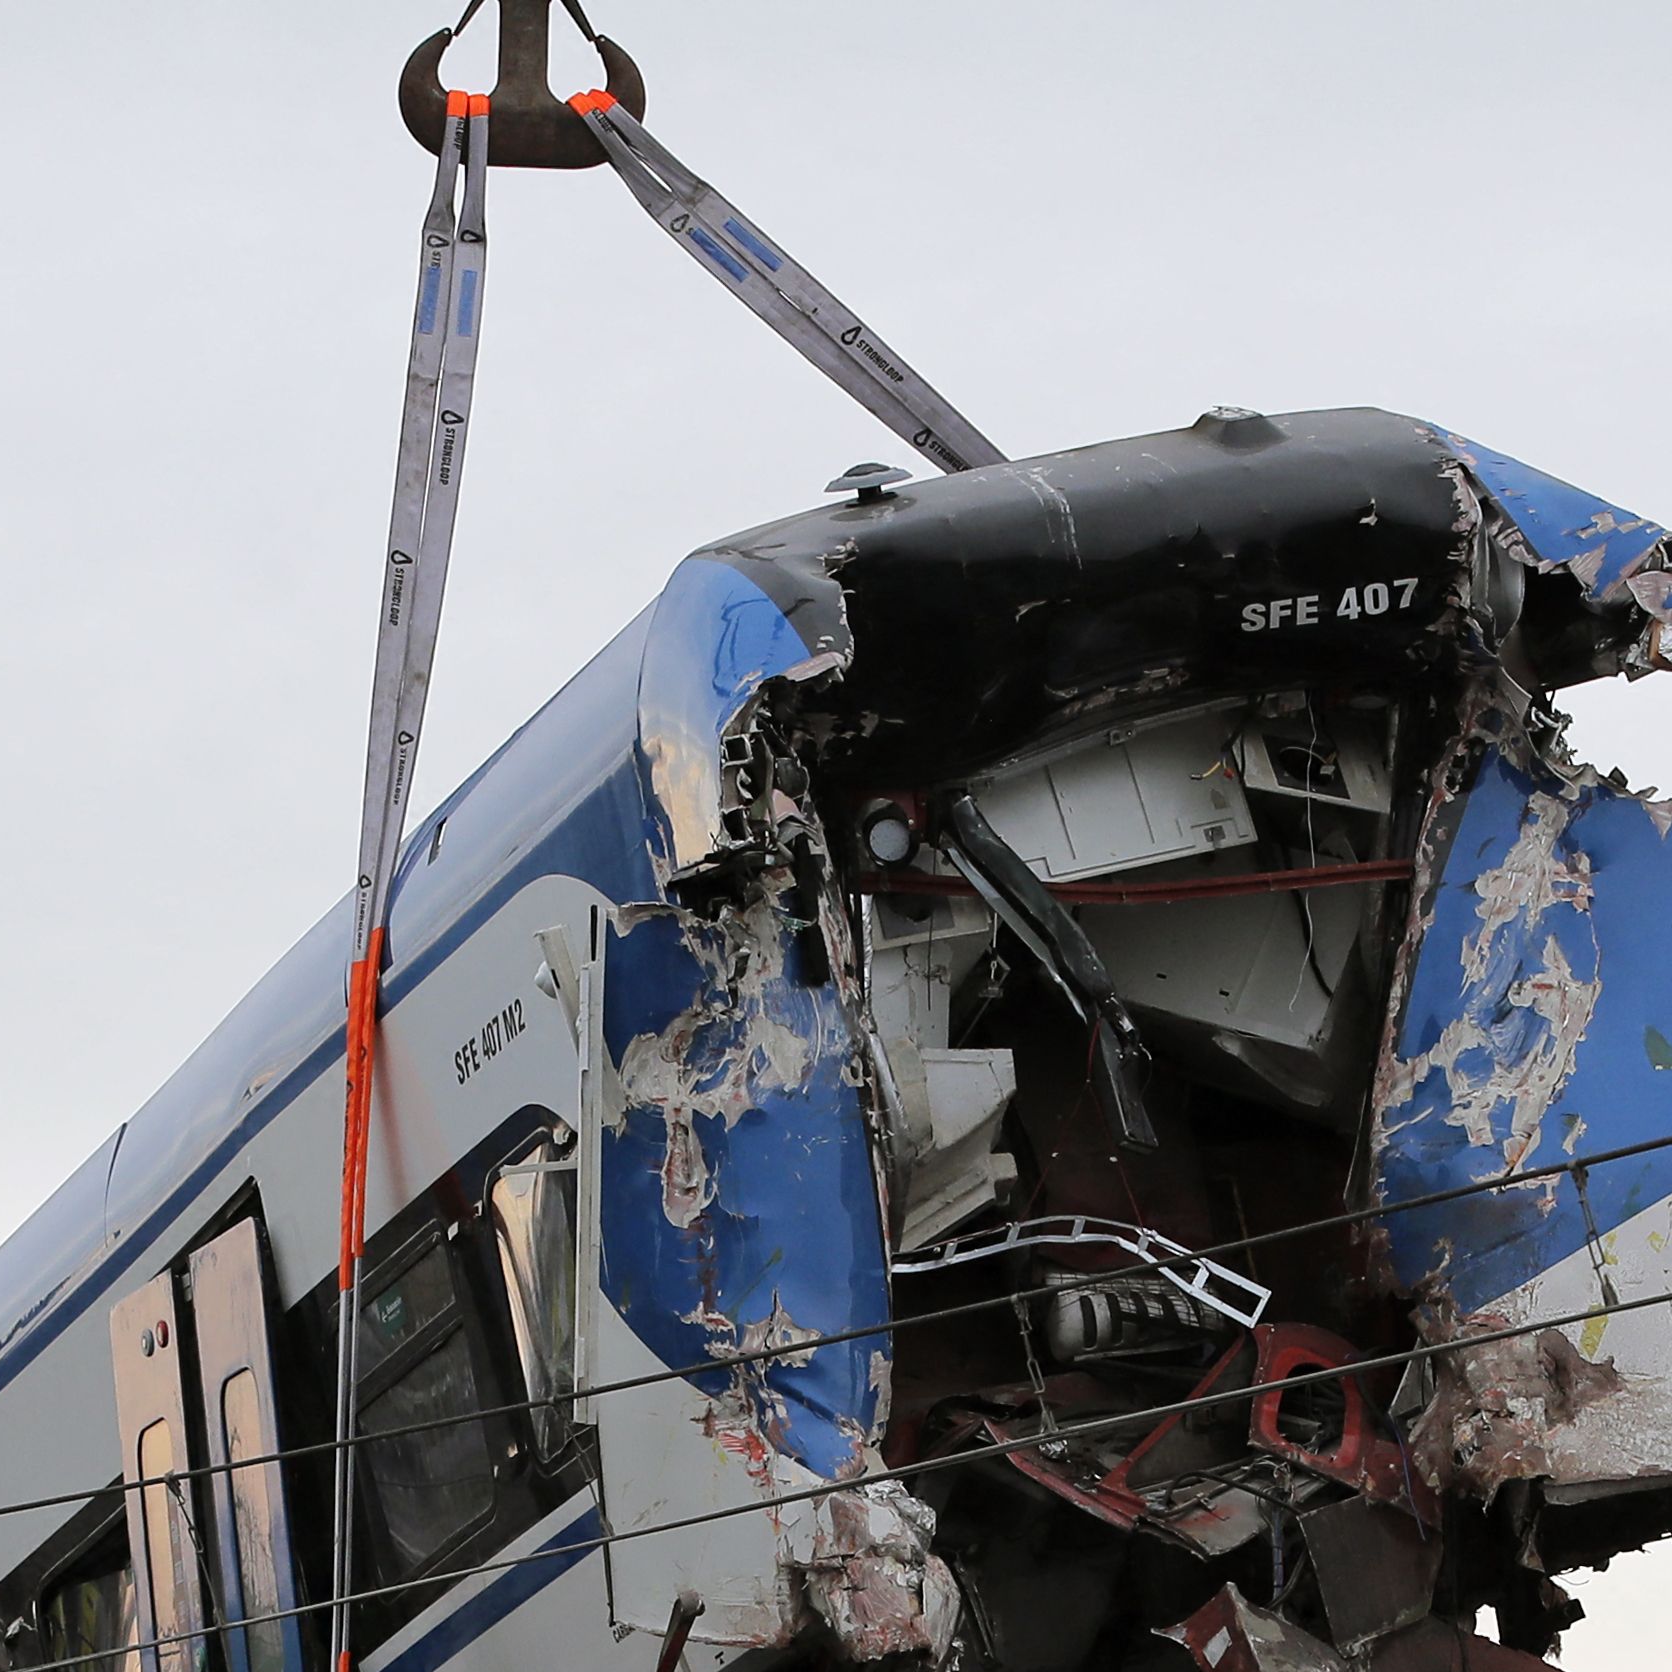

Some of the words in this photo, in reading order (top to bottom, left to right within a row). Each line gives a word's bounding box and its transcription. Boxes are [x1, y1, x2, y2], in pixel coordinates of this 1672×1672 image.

[855, 339, 904, 383] STRONGLOOP
[439, 427, 456, 486] STRONGLOOP
[388, 567, 405, 627] STRONGLOOP
[1240, 594, 1319, 632] SFE
[1336, 577, 1419, 620] 407
[454, 1036, 481, 1086] SFE
[482, 1014, 503, 1061] 407
[502, 997, 527, 1043] M2
